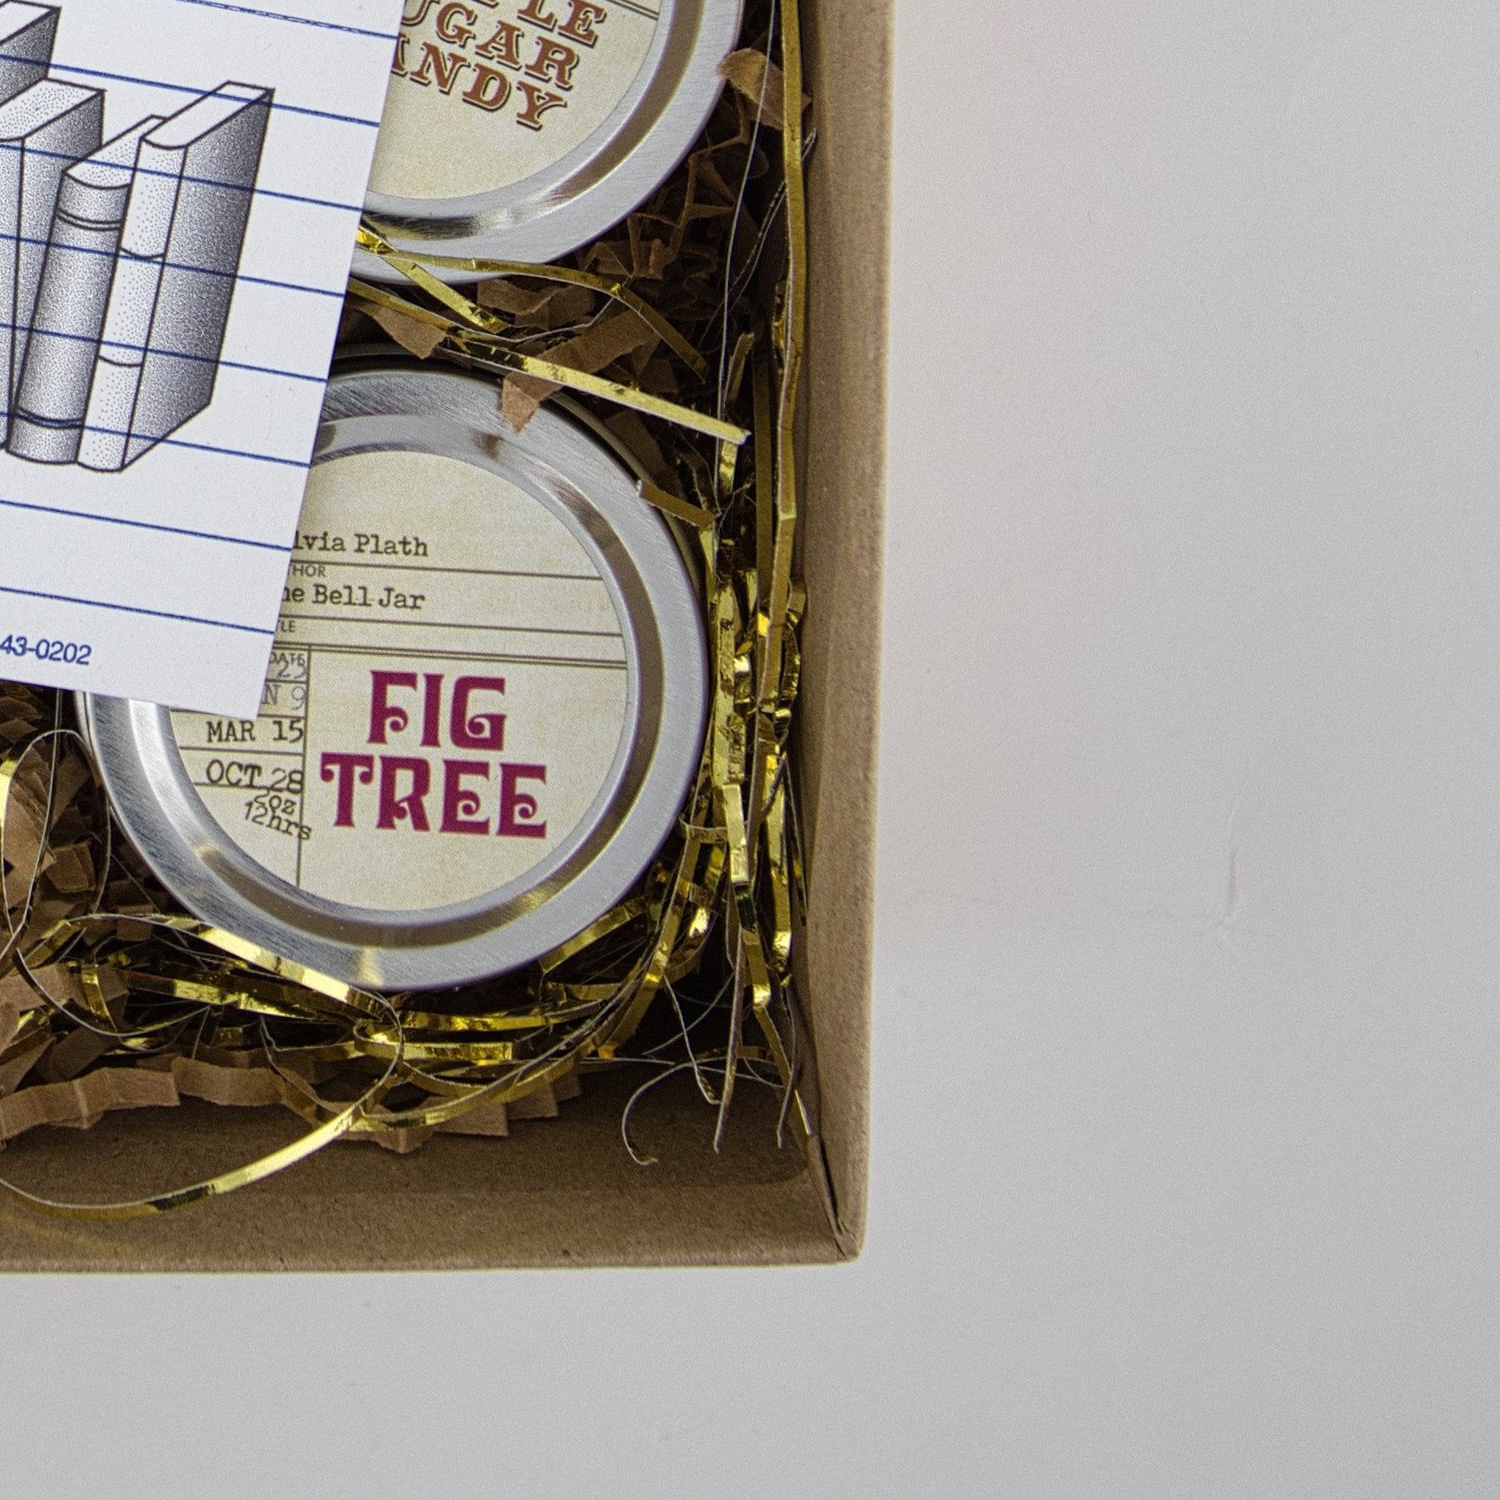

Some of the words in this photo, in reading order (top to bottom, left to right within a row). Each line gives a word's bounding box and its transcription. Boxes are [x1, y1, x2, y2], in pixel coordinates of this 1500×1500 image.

[353, 532, 430, 558] Plath
[288, 564, 327, 578] HOR
[311, 582, 373, 607] Bell
[378, 586, 426, 610] Jar
[367, 669, 508, 752] FIG
[206, 720, 257, 743] MAR
[271, 719, 304, 743] 15
[205, 759, 263, 788] OCT
[271, 767, 304, 795] 28
[320, 751, 548, 839] TREE
[244, 801, 313, 841] 12hrs
